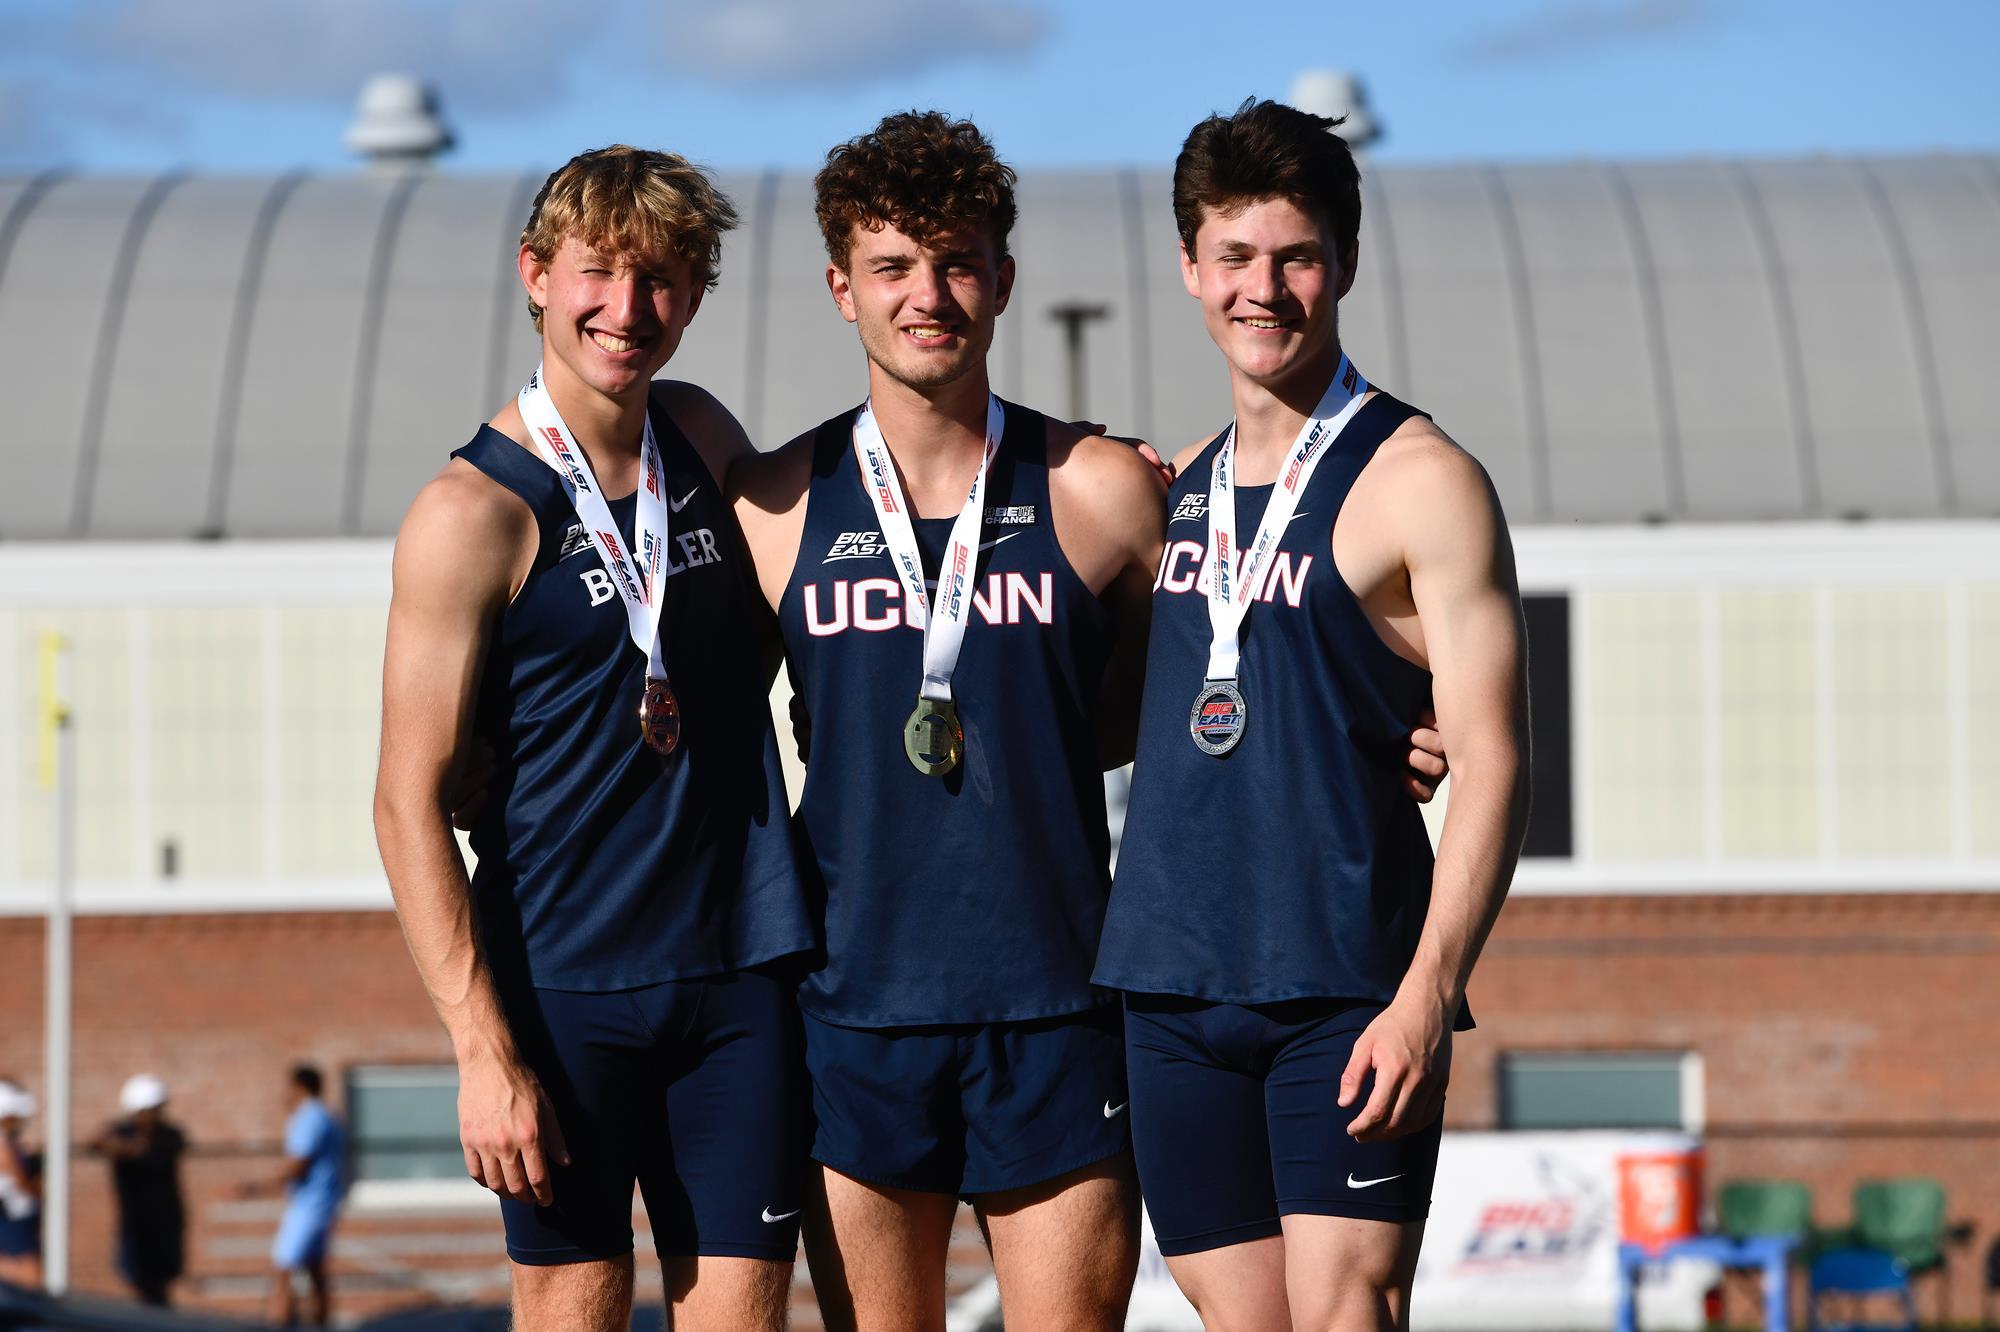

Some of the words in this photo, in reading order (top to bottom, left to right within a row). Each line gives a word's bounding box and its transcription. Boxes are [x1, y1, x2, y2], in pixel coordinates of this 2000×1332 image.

[1180, 493, 1207, 506] BIG
[1173, 507, 1210, 518] EAST
[985, 516, 1035, 525] CHANGE
[564, 523, 590, 541] BI
[834, 531, 880, 545] BIG
[560, 533, 594, 554] EAS
[826, 544, 889, 557] EAST
[579, 528, 722, 608] BLER
[1203, 703, 1233, 715] BIG
[1198, 715, 1241, 726] EAST
